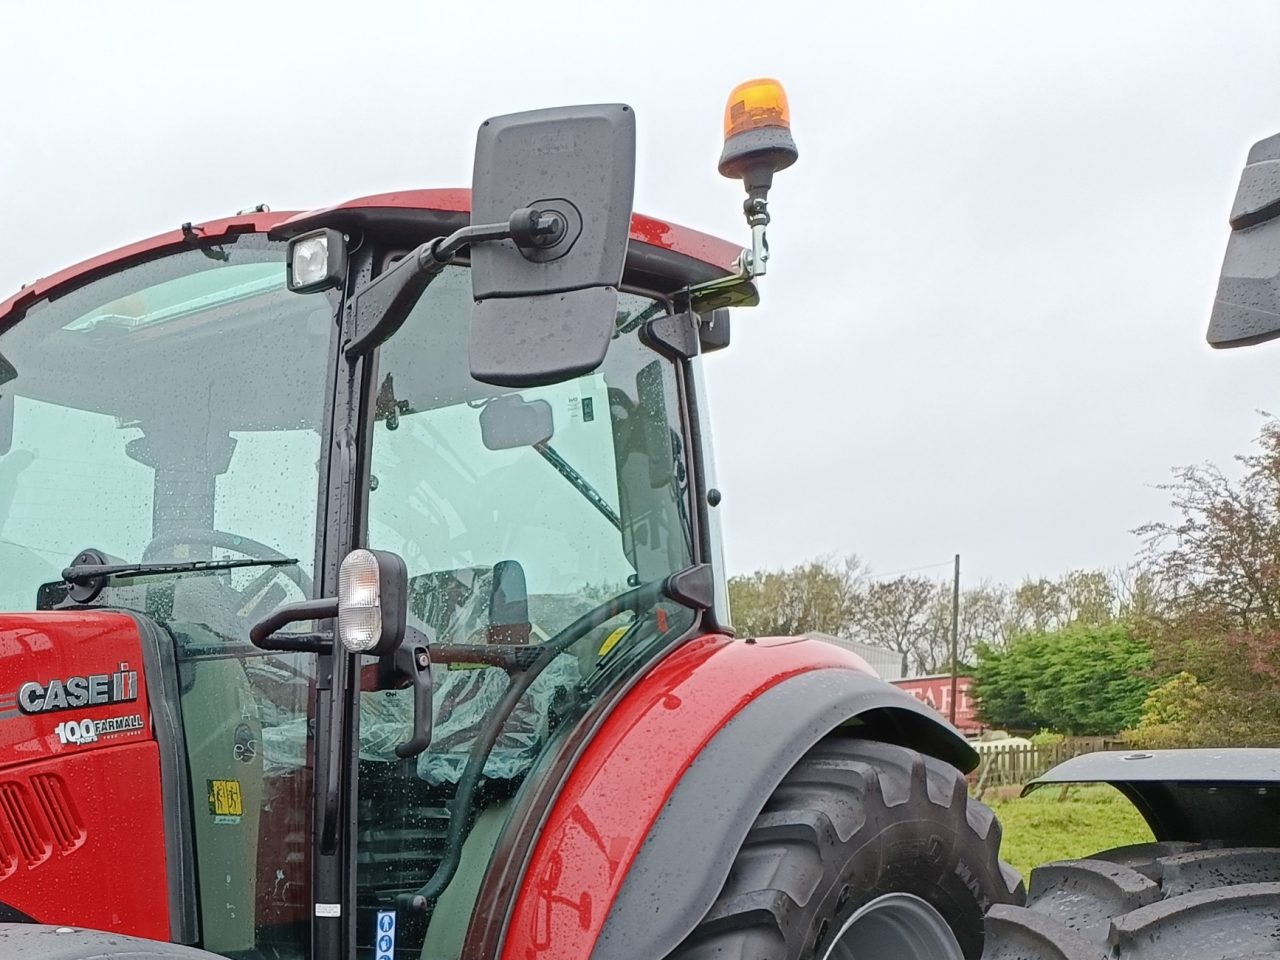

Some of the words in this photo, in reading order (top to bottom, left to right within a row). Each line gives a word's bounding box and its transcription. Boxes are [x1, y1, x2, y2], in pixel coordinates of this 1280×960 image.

[19, 674, 109, 713] CASE
[55, 718, 97, 744] 100
[94, 714, 143, 734] FARMALL
